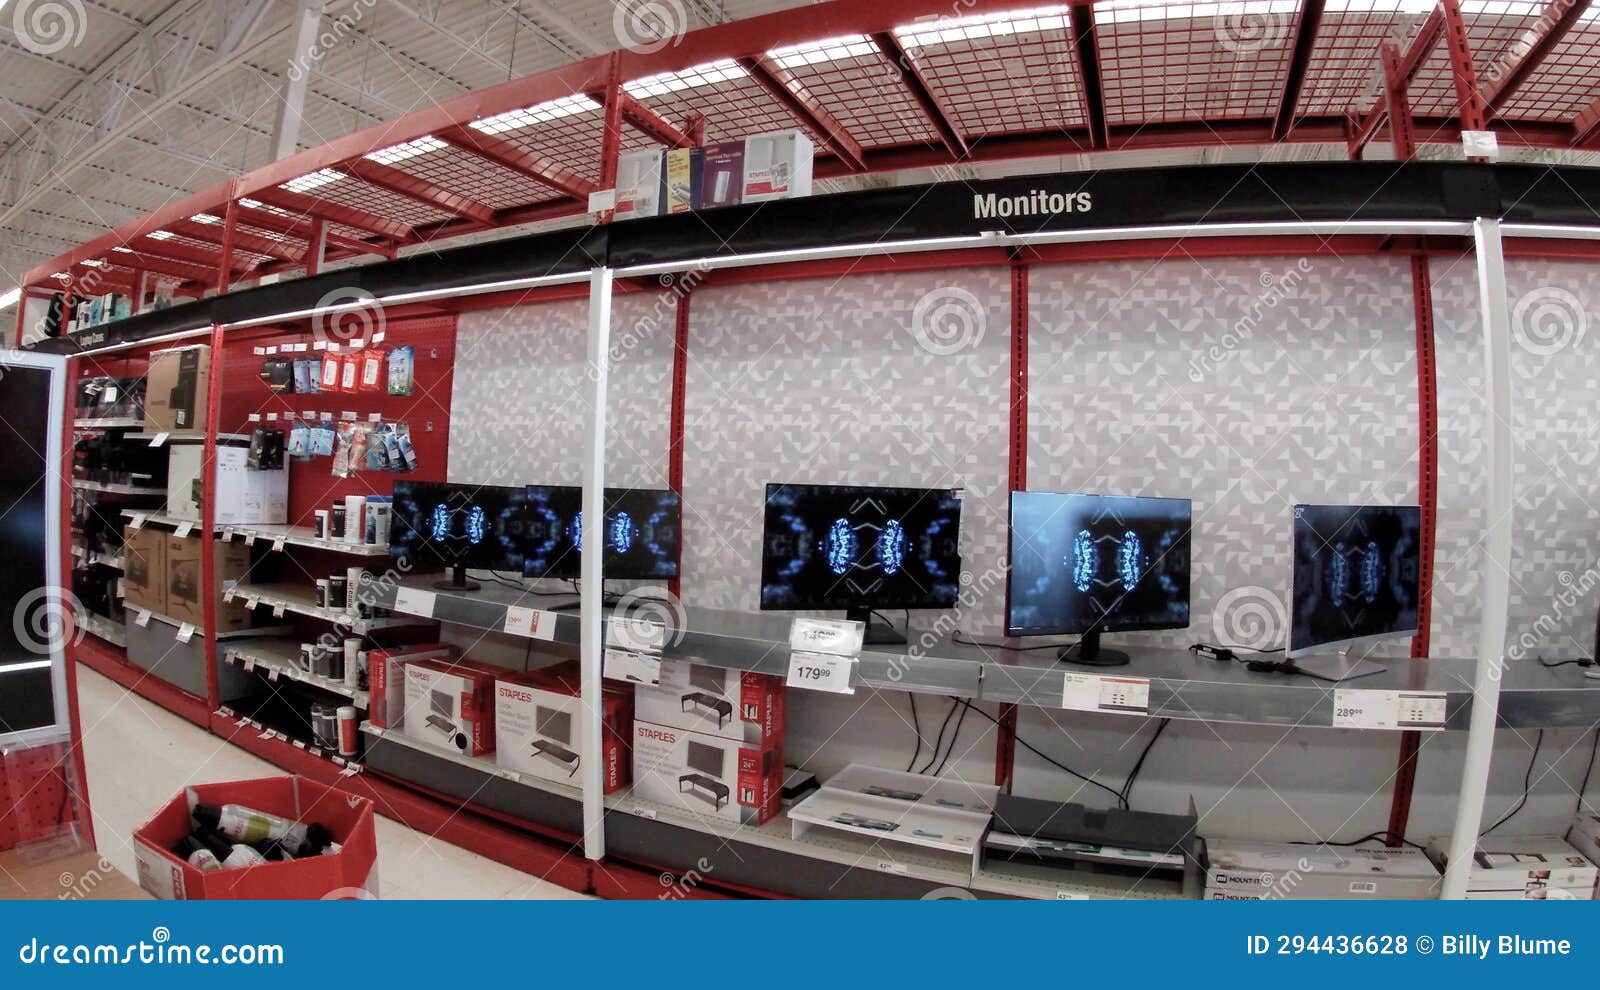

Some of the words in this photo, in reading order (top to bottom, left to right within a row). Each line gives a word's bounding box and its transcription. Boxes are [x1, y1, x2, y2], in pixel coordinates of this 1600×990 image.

[974, 190, 1092, 219] Monitors
[499, 687, 532, 703] STAPLES
[638, 727, 676, 743] STAPLES
